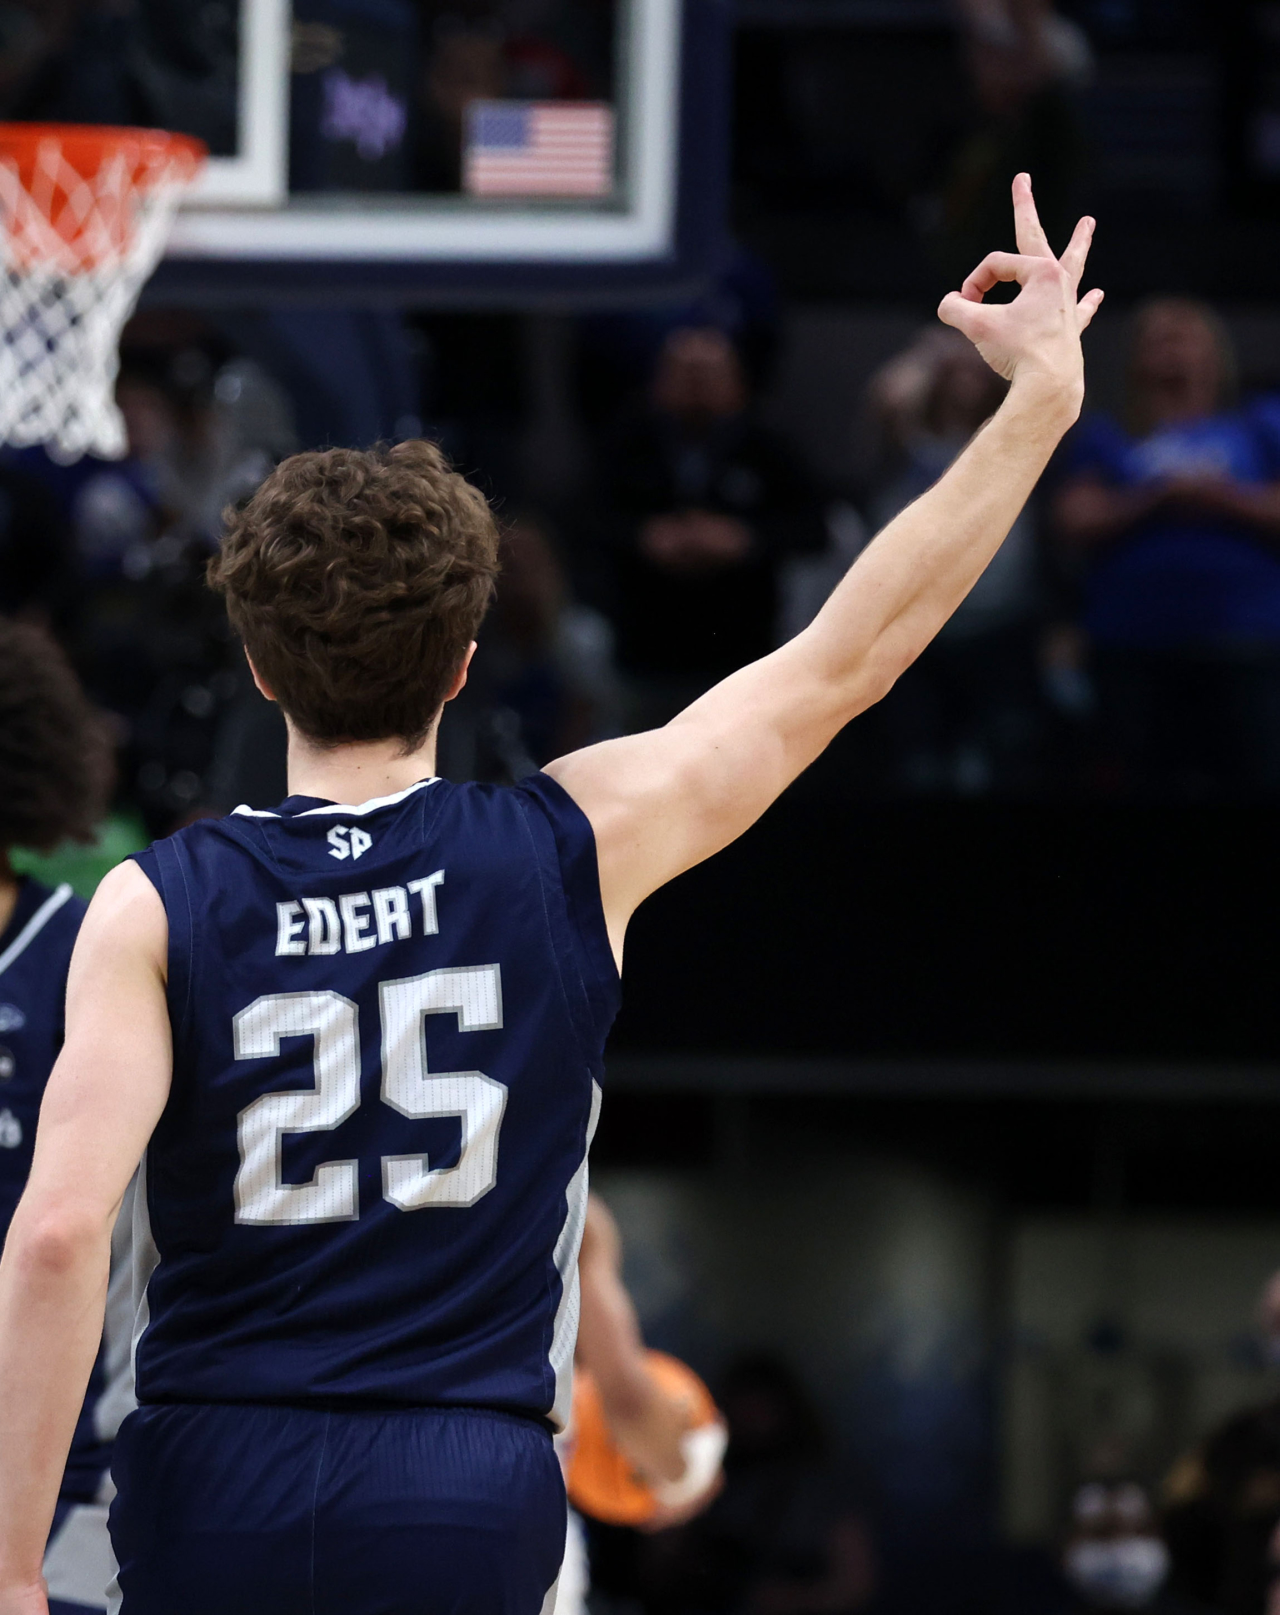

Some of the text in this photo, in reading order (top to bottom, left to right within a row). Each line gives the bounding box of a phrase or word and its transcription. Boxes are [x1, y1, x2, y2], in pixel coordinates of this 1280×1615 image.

[326, 824, 373, 861] SP
[275, 869, 446, 957] EDERT
[232, 963, 509, 1226] 25
